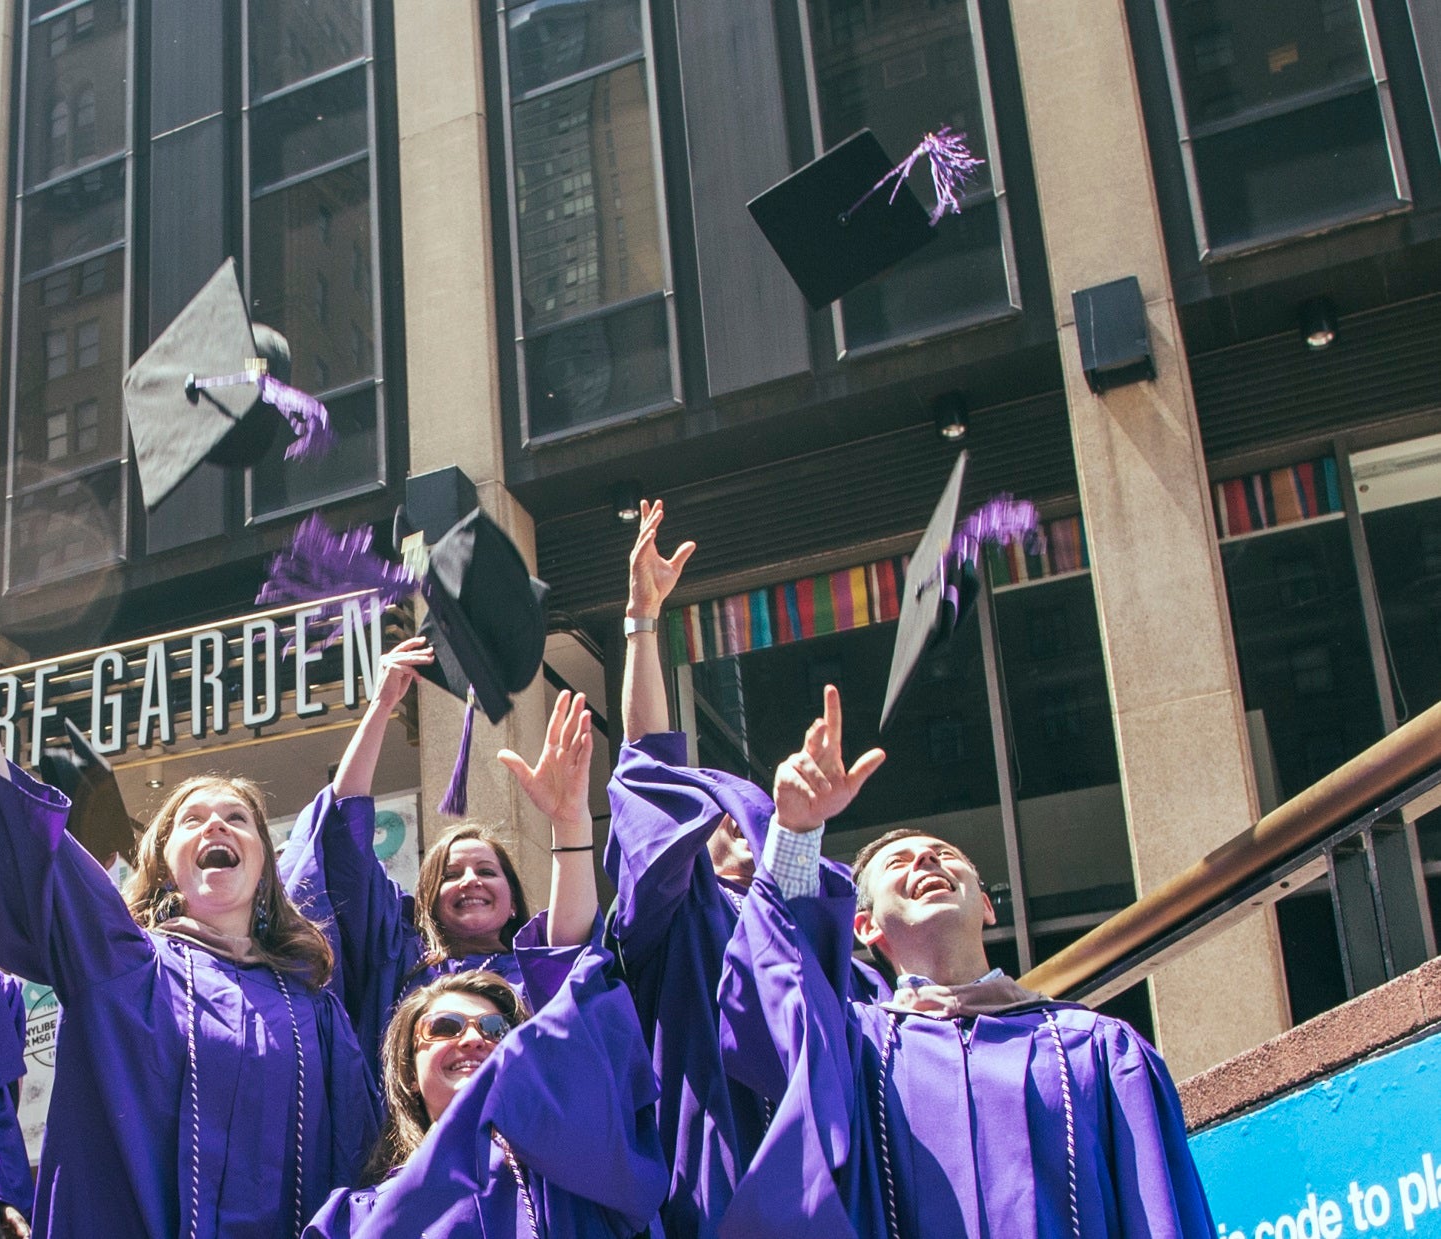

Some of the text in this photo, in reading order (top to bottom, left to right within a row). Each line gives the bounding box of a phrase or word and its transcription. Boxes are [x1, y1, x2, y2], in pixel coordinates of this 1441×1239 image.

[91, 595, 382, 754] GARDEN
[32, 1032, 50, 1046] MSG
[1347, 1181, 1390, 1231] to
[1398, 1153, 1441, 1231] pl
